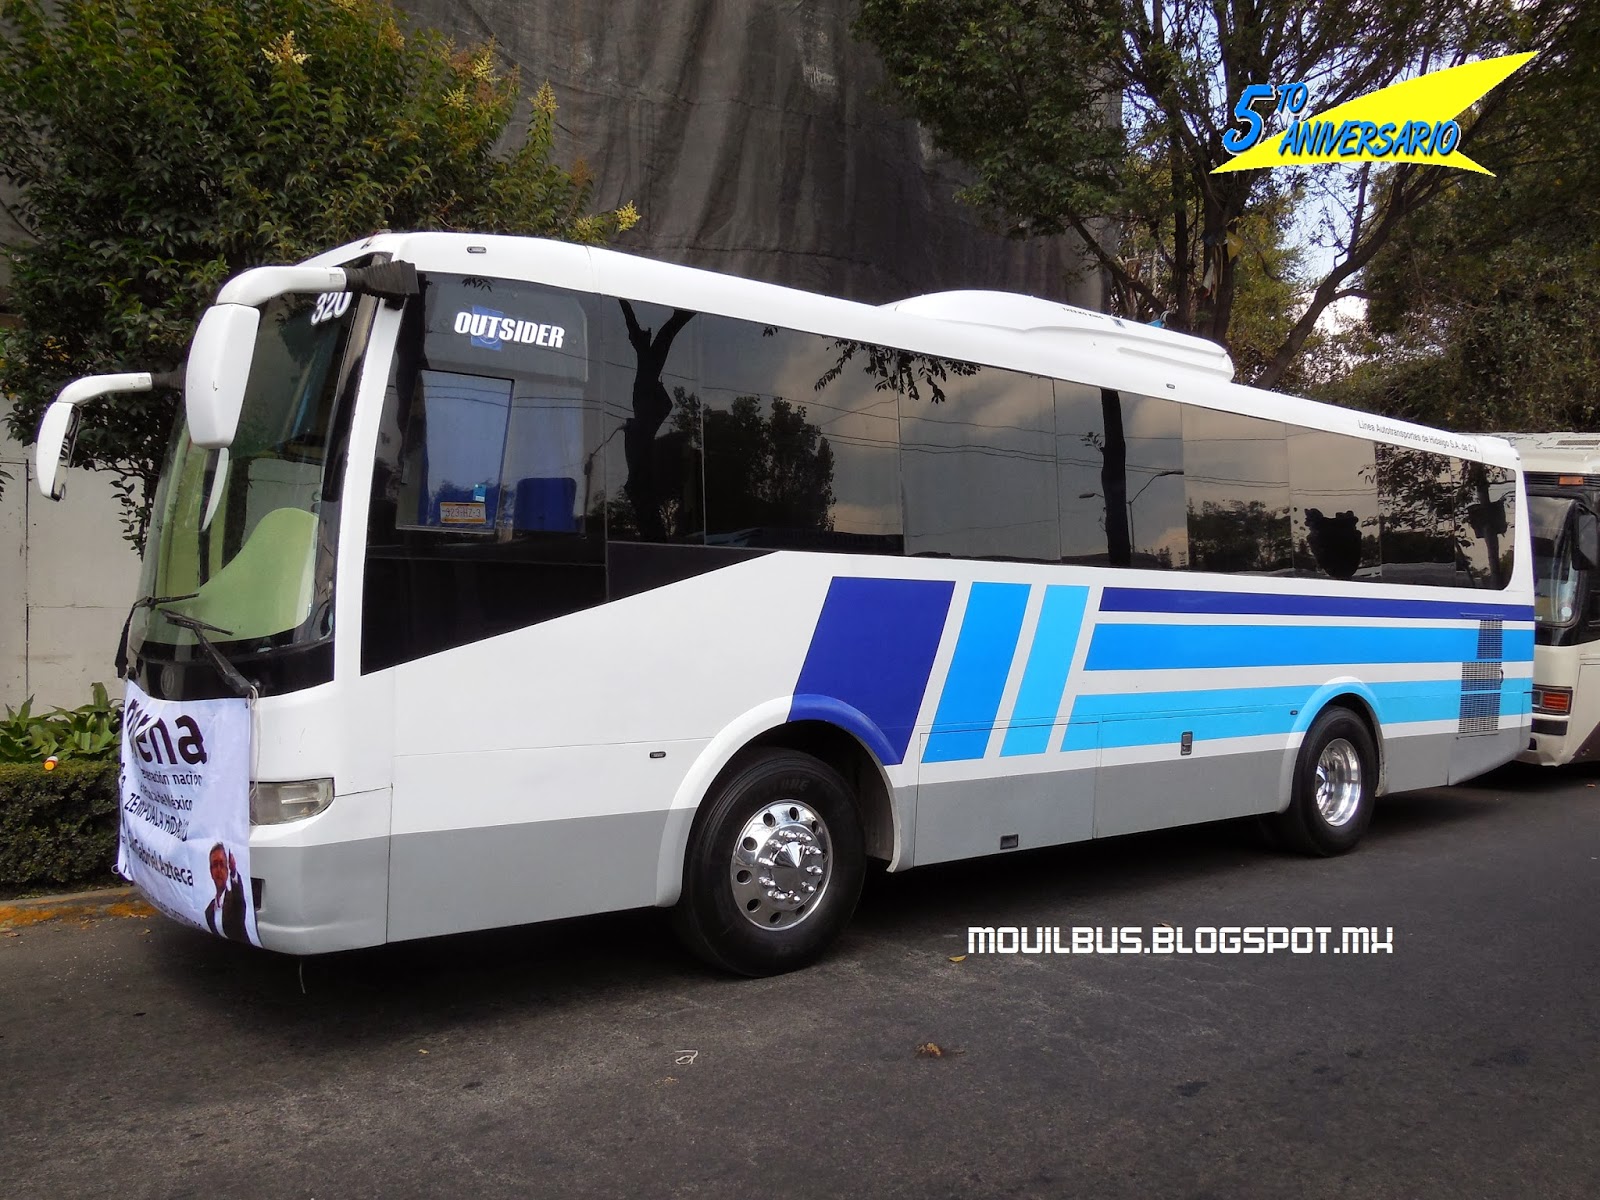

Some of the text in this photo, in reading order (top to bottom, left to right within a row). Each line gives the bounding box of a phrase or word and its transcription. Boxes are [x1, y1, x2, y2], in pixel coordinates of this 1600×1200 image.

[311, 291, 353, 326] 320
[454, 311, 565, 348] OUTSIDER
[1421, 434, 1429, 443] de
[1429, 435, 1450, 449] Hidalgo
[1461, 443, 1468, 451] de
